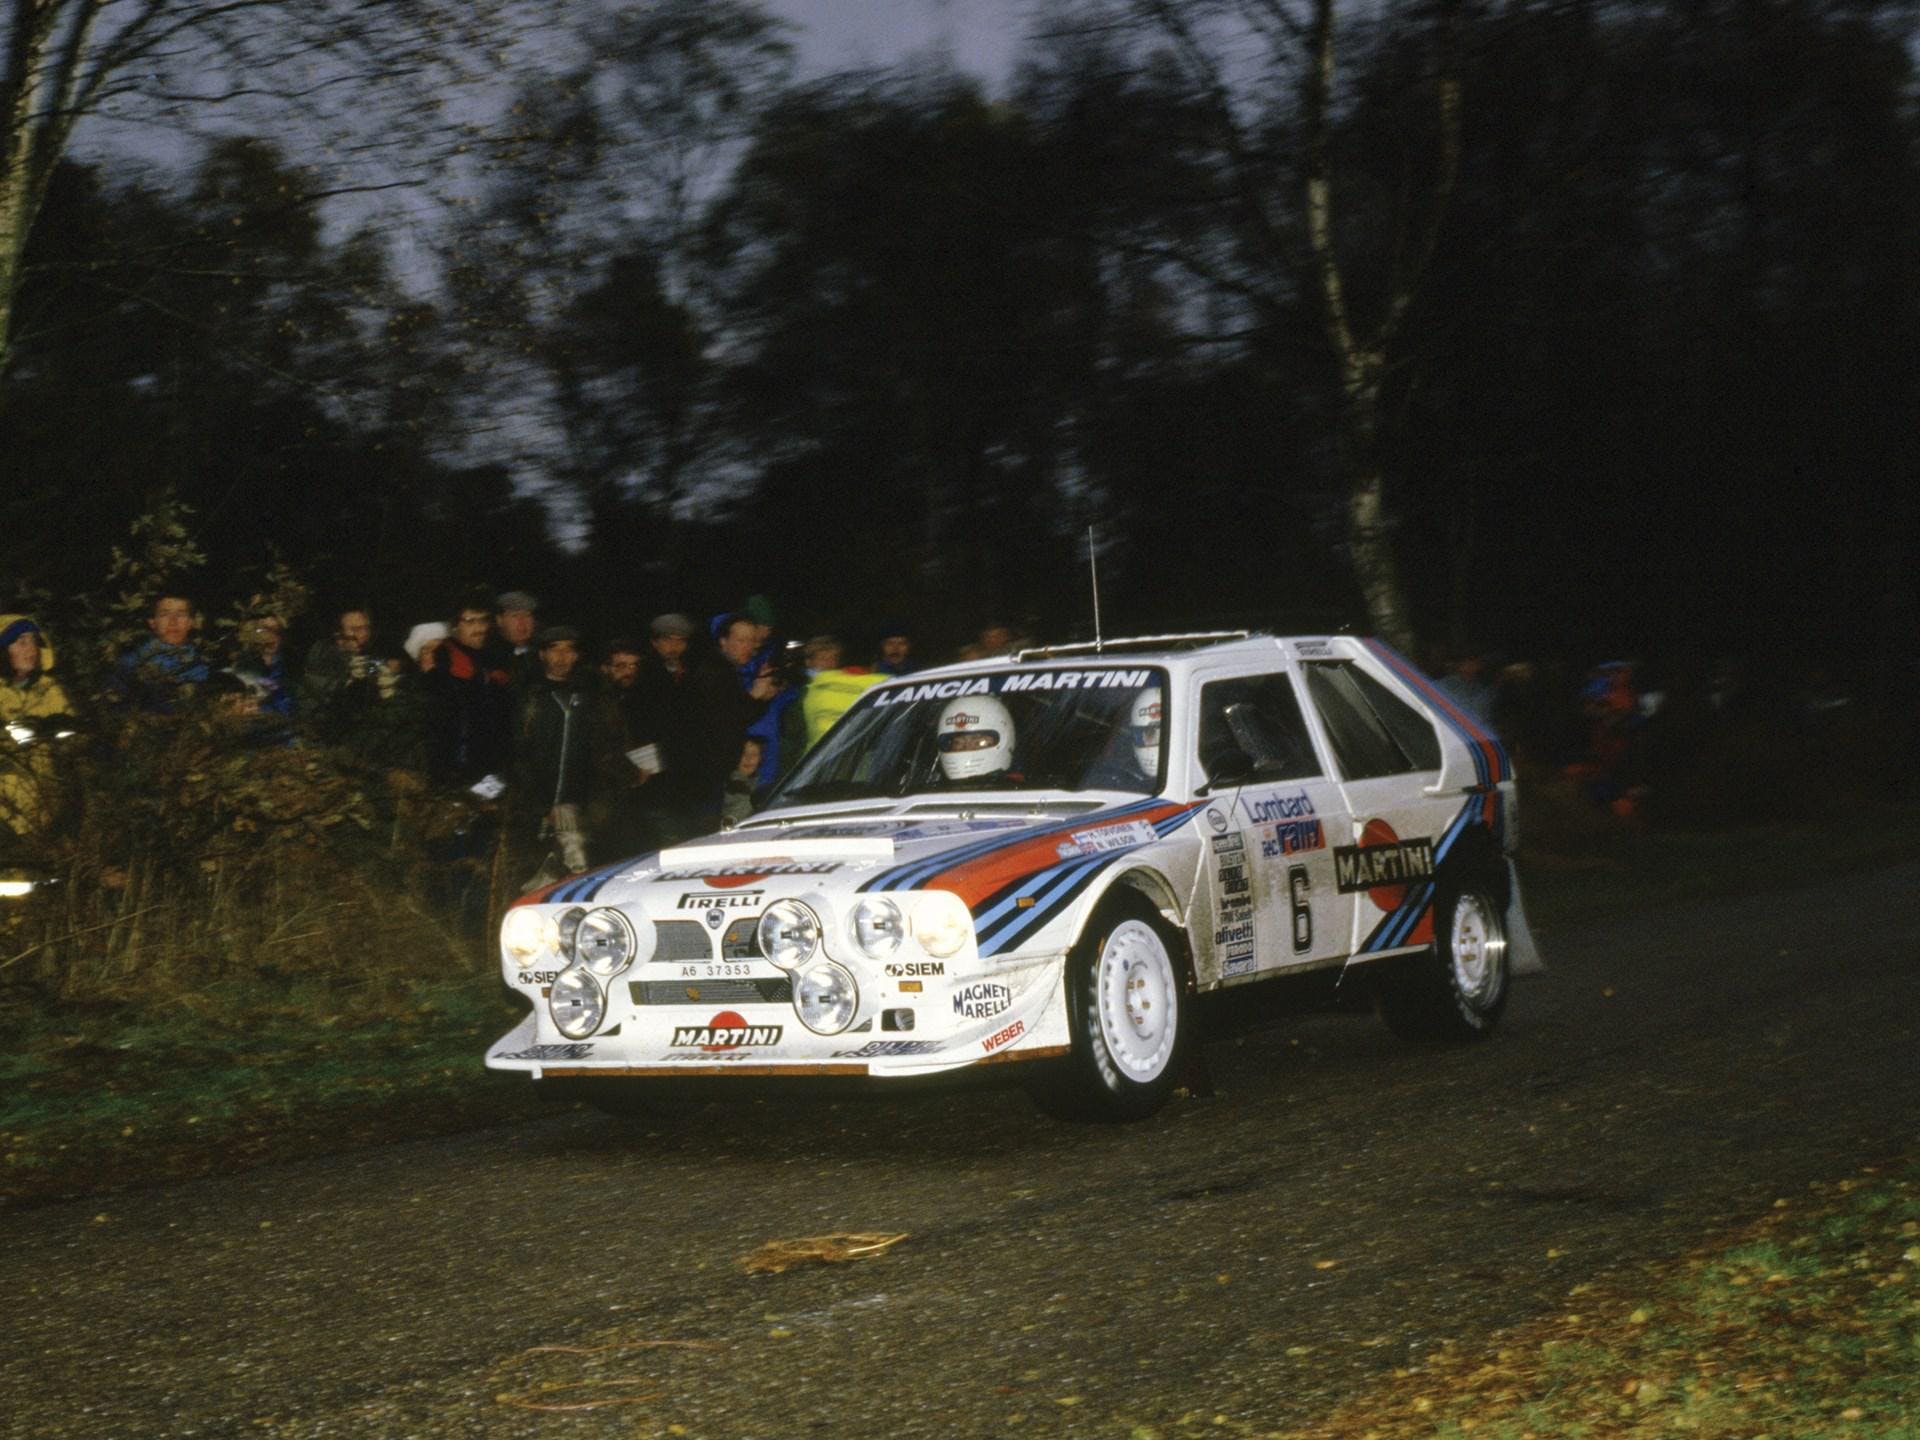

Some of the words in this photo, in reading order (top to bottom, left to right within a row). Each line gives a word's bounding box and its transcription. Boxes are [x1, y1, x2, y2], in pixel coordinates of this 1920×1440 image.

[873, 677, 991, 708] LANCIA
[1000, 669, 1151, 693] MARTINI
[1240, 788, 1315, 824] Lombard
[1336, 845, 1433, 887] MARTINI
[676, 889, 766, 910] PIRELLI
[1288, 863, 1312, 955] 6
[1215, 919, 1254, 945] olivetti
[706, 964, 751, 976] 37353
[904, 962, 945, 976] SIEM
[953, 983, 1011, 1013] MAGNETI
[673, 1028, 780, 1046] MARTINI
[981, 1020, 1025, 1052] WEBER
